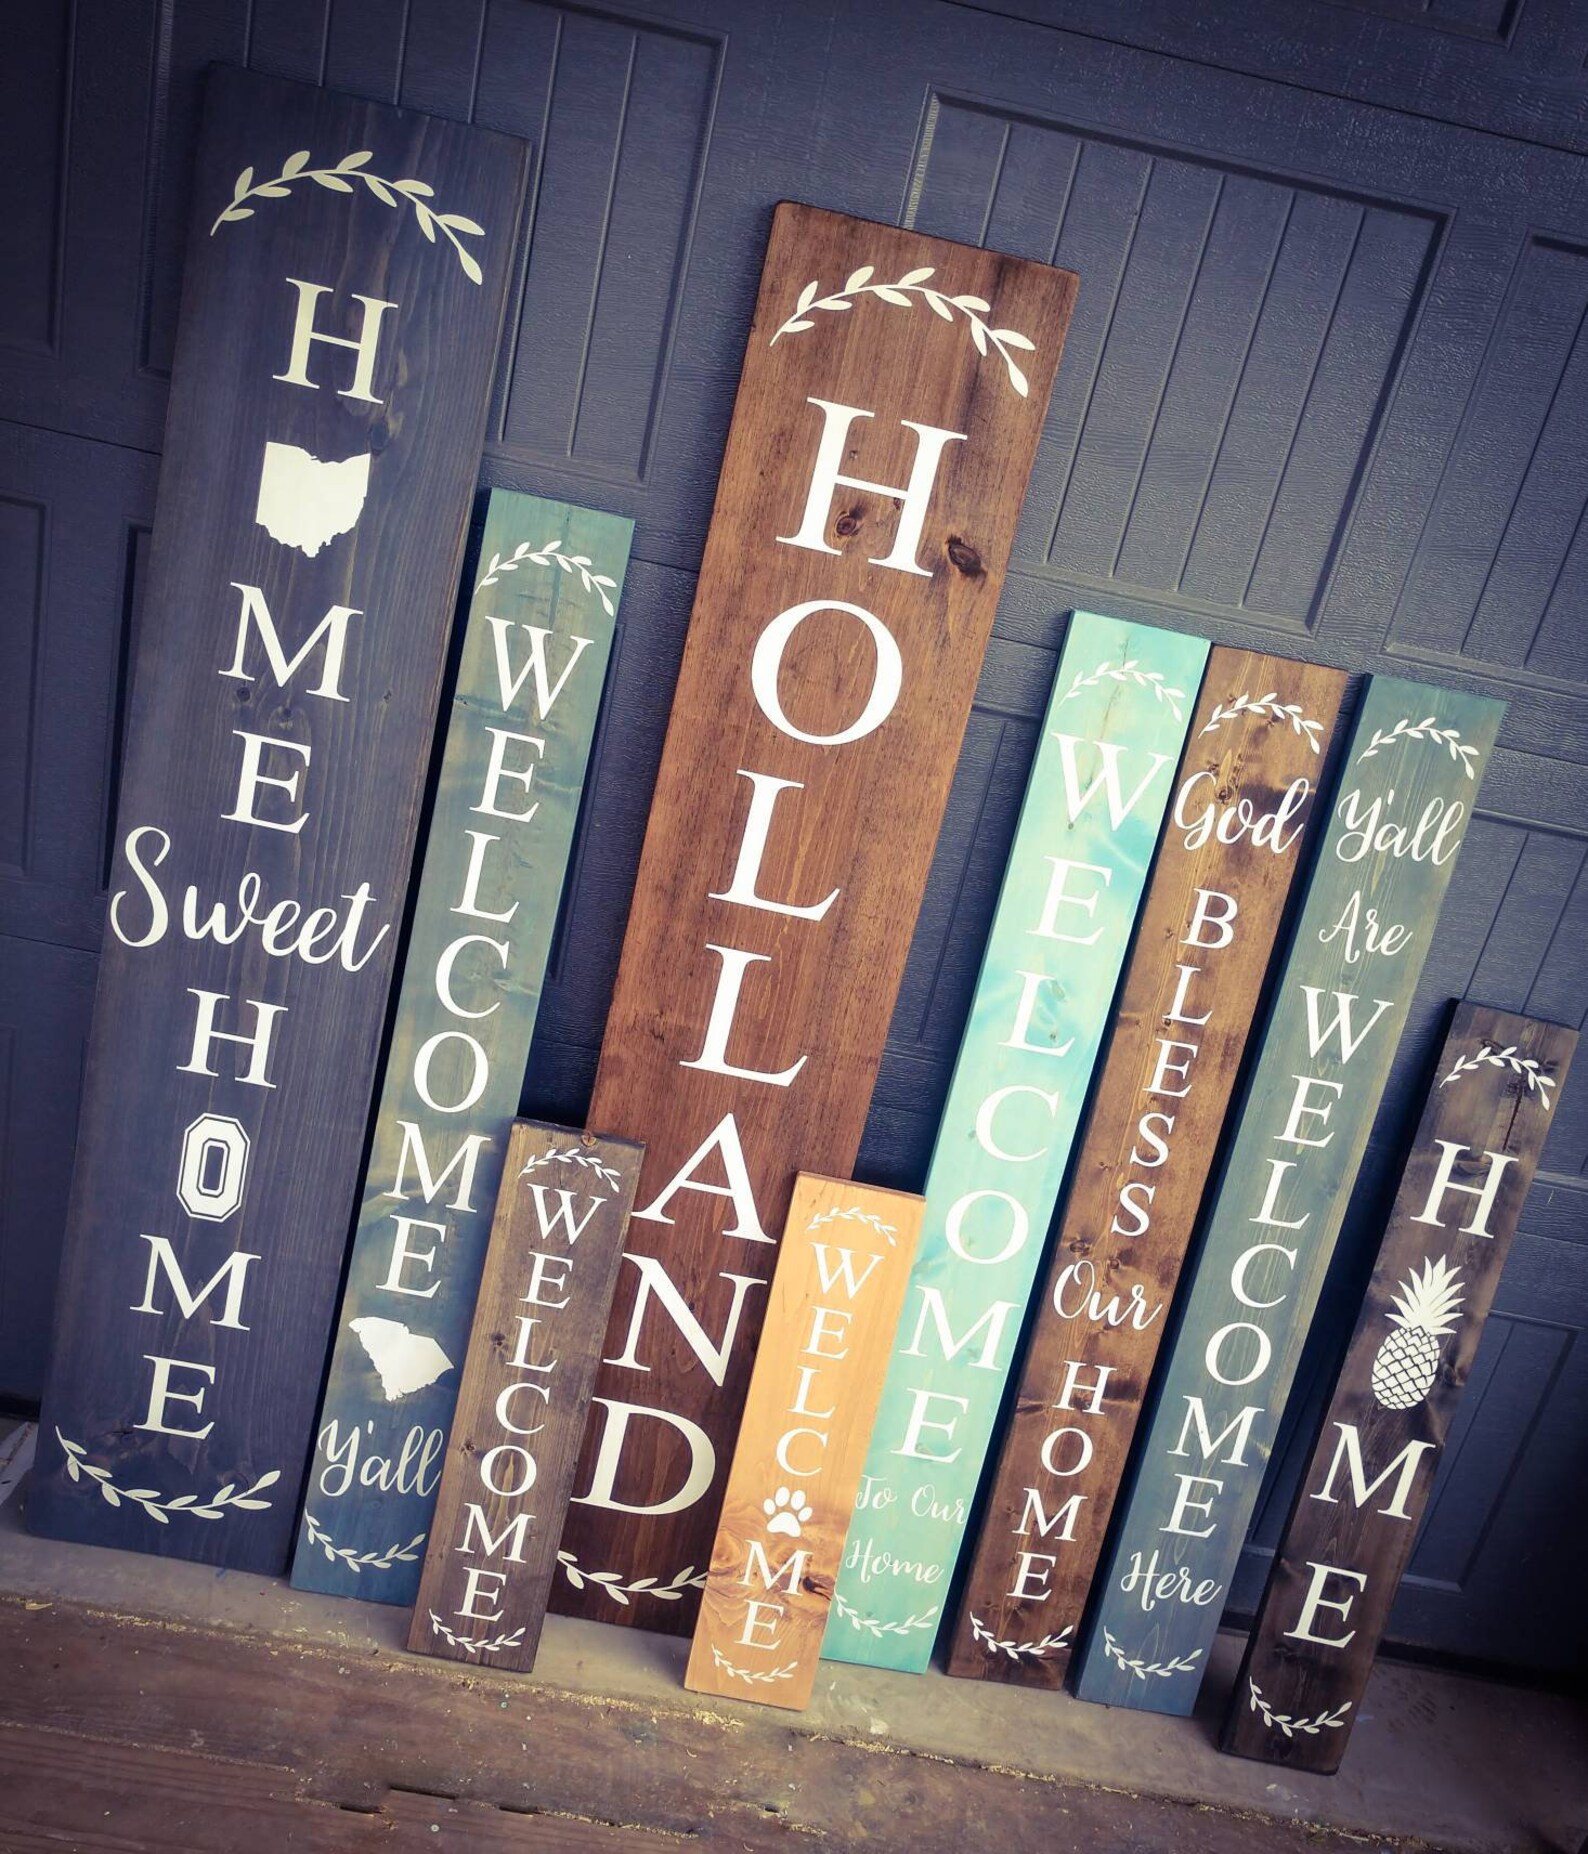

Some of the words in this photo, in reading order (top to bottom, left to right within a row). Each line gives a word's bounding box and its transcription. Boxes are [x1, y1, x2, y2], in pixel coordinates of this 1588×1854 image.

[1173, 771, 1310, 855] God
[1335, 789, 1464, 866] Y'all
[110, 825, 391, 972] Sweet
[375, 616, 594, 1299] WELCOME
[570, 397, 968, 1515] HOLLAND
[1319, 890, 1412, 963] Are
[890, 732, 1174, 1463] WELCOME
[1110, 888, 1238, 1237] BLESS
[129, 987, 288, 1440] HOME
[1159, 985, 1394, 1539] WELCOME
[1053, 1259, 1162, 1331] Our
[317, 1418, 444, 1497] Y'all
[454, 1183, 607, 1622] WELCOME
[855, 1475, 897, 1512] To
[911, 1482, 966, 1524] Our
[1005, 1361, 1117, 1601] HOME
[845, 1538, 944, 1584] Home
[1120, 1550, 1222, 1611] Here
